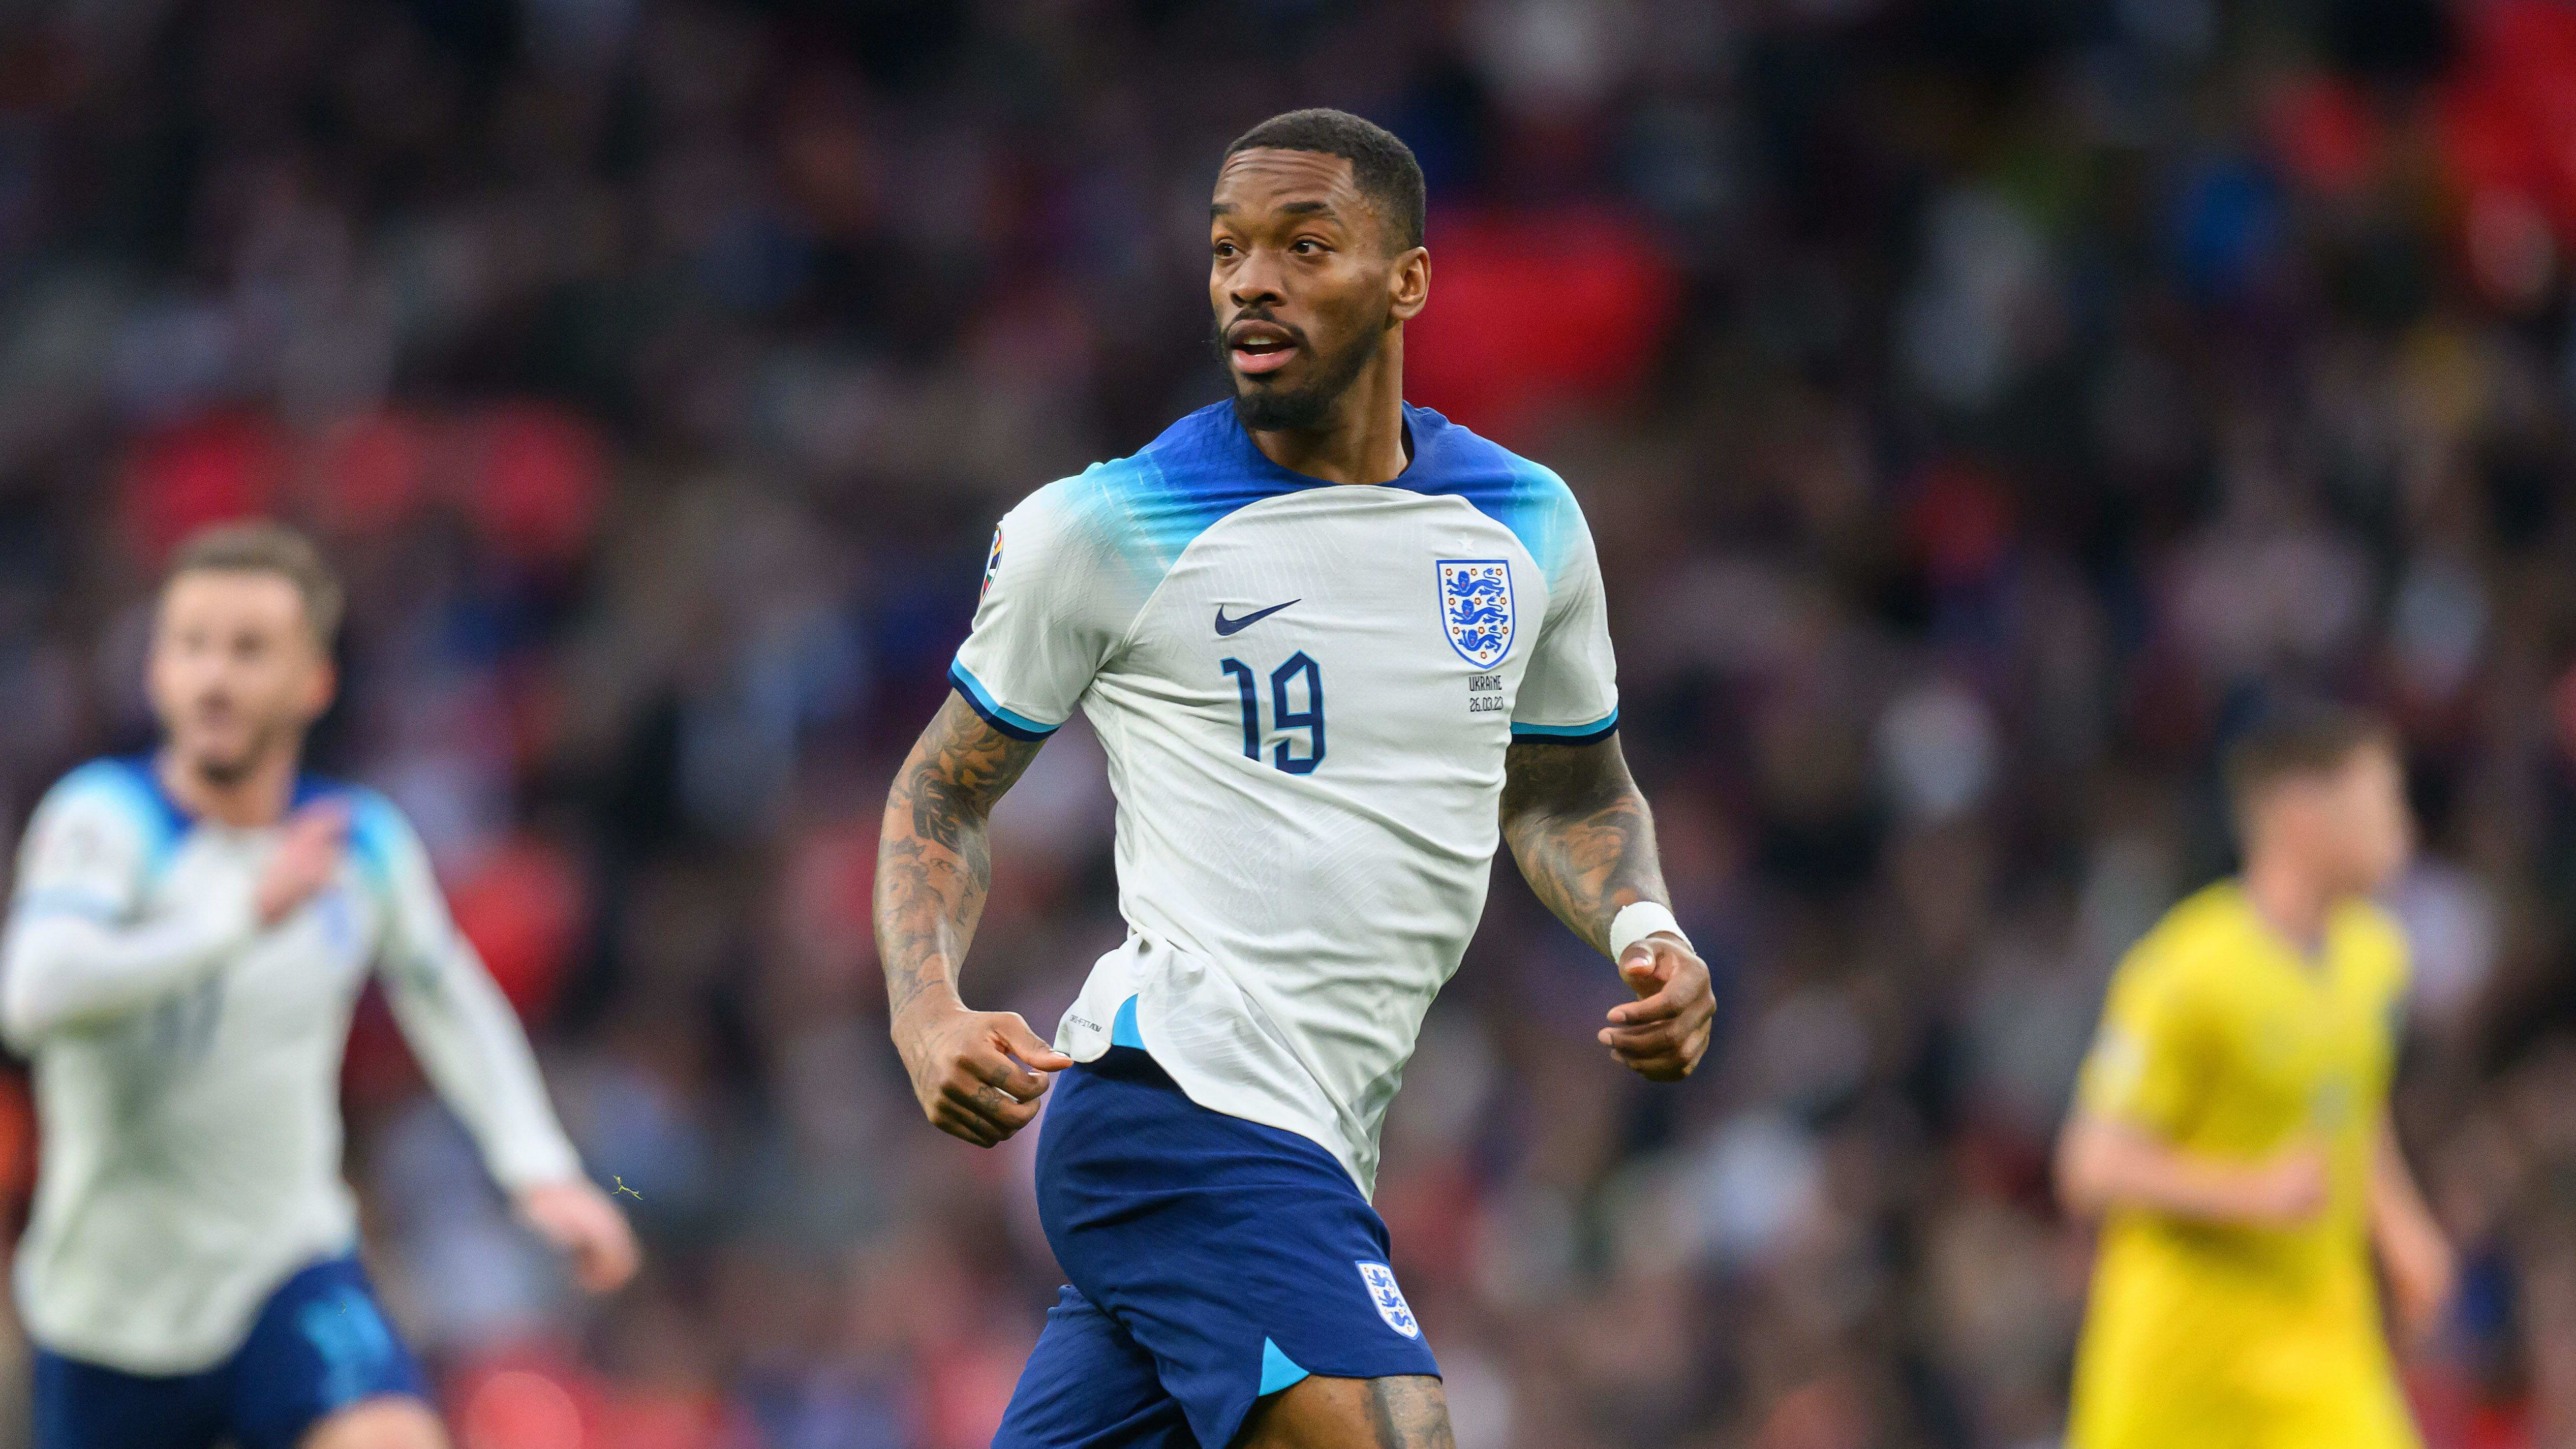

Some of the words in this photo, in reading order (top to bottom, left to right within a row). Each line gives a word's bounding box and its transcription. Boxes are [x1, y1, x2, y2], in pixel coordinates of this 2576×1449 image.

[1469, 675, 1502, 691] UKRAINE
[1470, 696, 1504, 712] 26.03.23
[1221, 650, 1326, 775] 19
